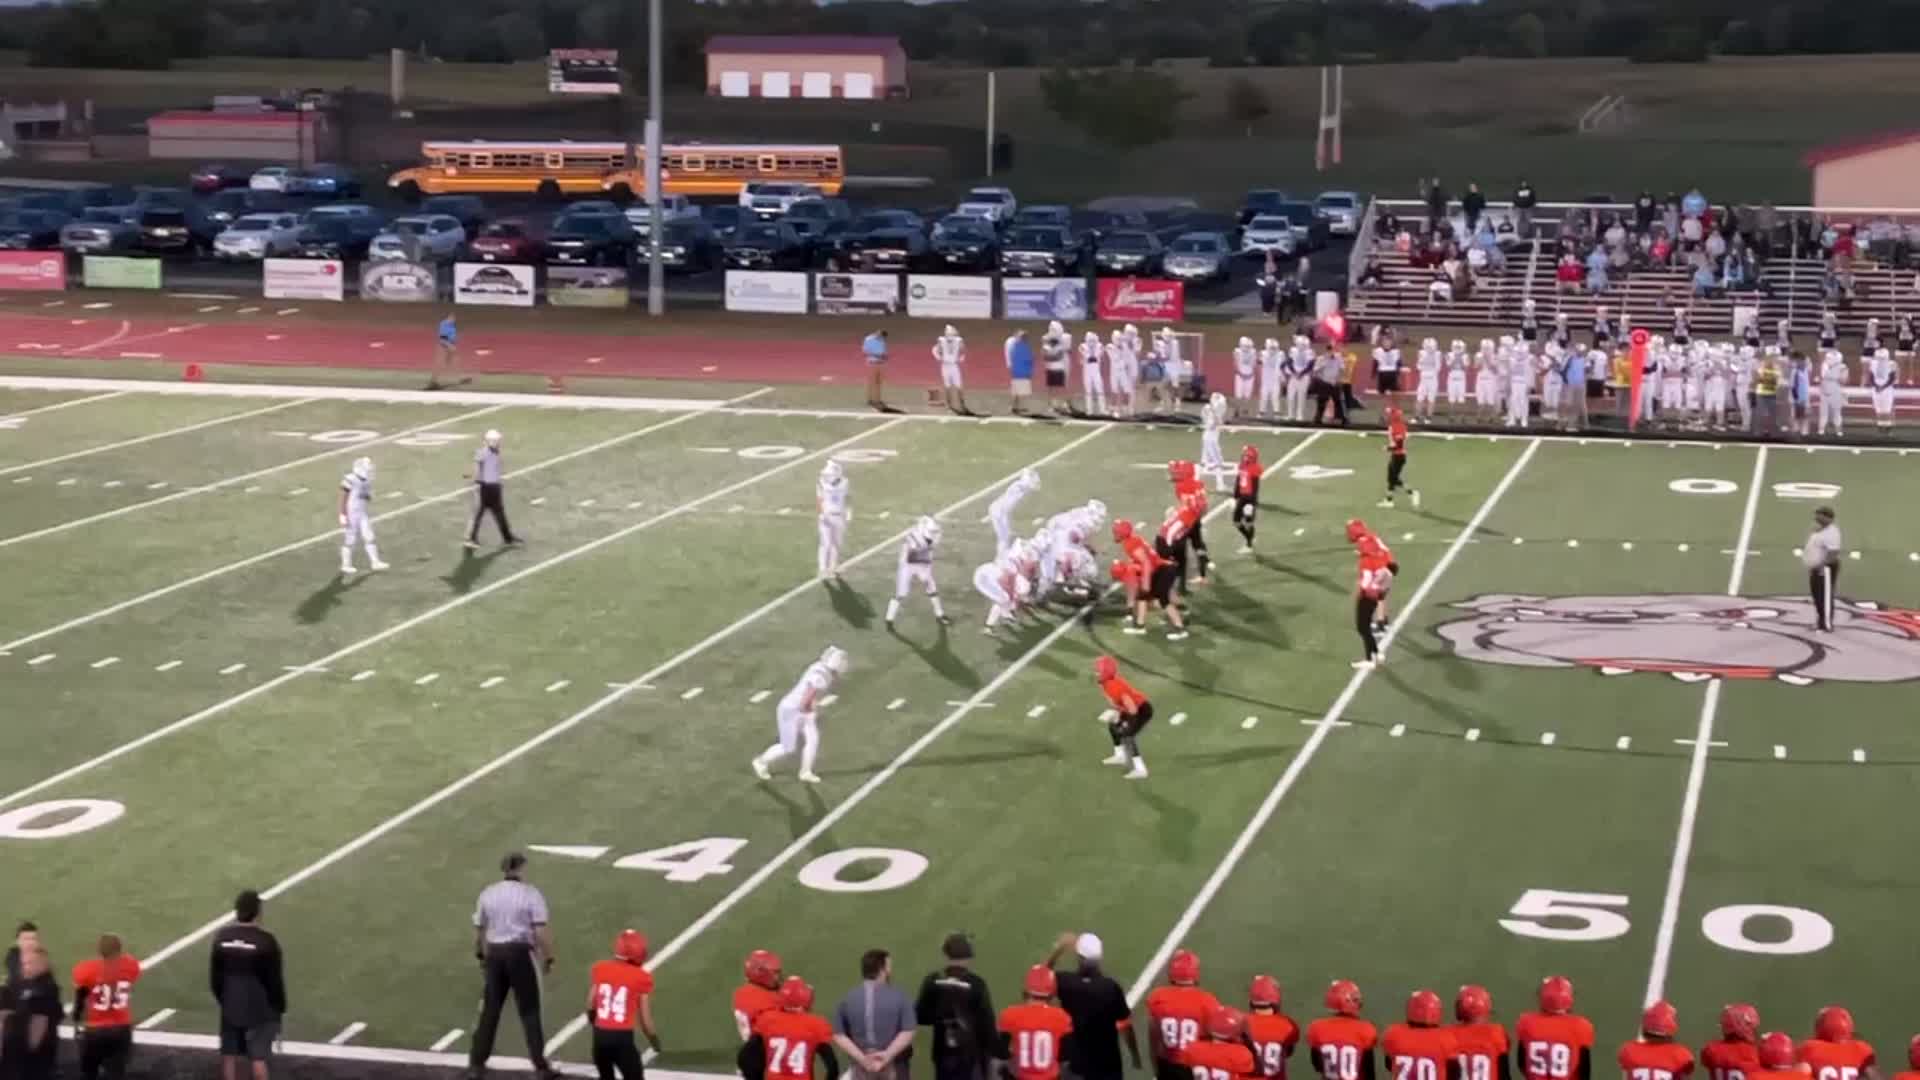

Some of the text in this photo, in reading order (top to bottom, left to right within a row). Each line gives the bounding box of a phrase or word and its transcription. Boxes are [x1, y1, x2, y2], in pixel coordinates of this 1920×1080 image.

[93, 981, 131, 1010] 35
[597, 983, 628, 1022] 34
[768, 1037, 807, 1074] 74
[1019, 1031, 1053, 1067] 10
[1320, 1043, 1359, 1080] 20
[1529, 1041, 1571, 1077] 58
